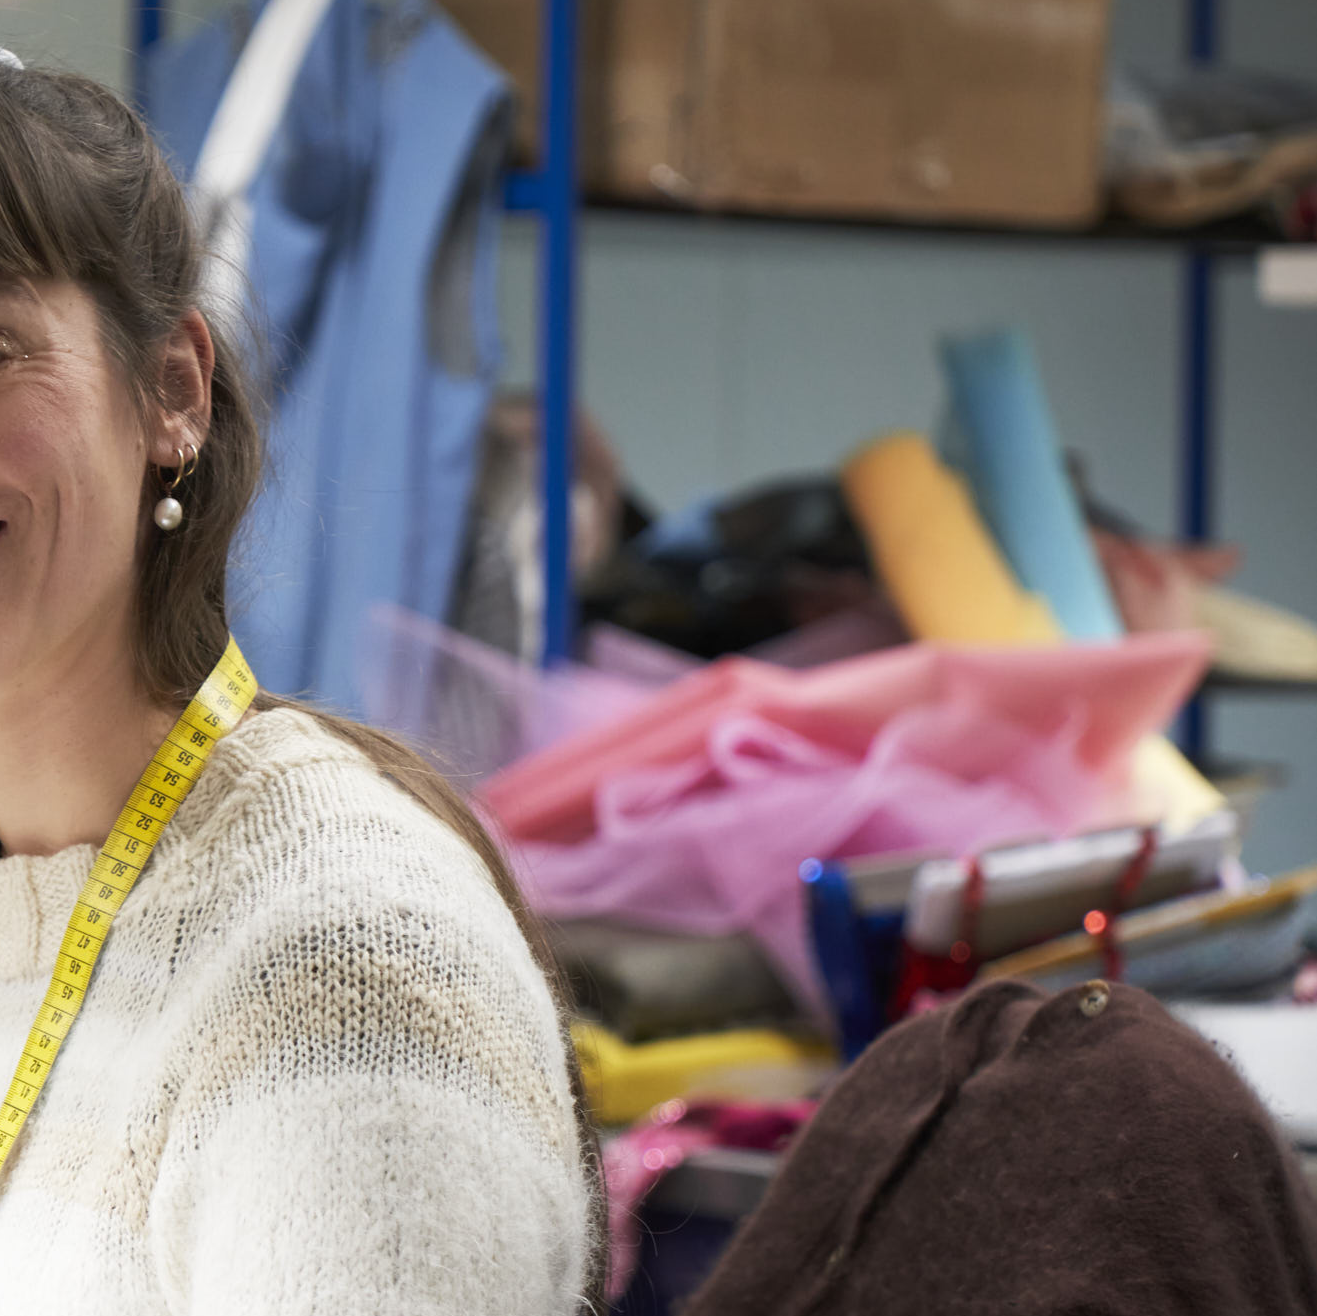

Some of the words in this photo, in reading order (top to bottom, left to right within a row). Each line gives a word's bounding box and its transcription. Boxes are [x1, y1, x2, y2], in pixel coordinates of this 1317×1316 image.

[204, 713, 220, 727] 57
[190, 731, 207, 747] 56
[176, 751, 193, 766] 55
[162, 770, 180, 787] 54
[149, 792, 166, 809] 53
[135, 815, 152, 831] 52
[124, 838, 139, 854] 51
[110, 862, 128, 877] 50
[99, 886, 113, 900] 49
[87, 909, 100, 924] 48
[77, 935, 90, 949] 47
[69, 960, 81, 975] 46
[61, 985, 74, 1000] 45
[50, 1010, 63, 1024] 44
[39, 1035, 51, 1049] 43
[29, 1059, 41, 1074] 42
[20, 1086, 31, 1099] 41
